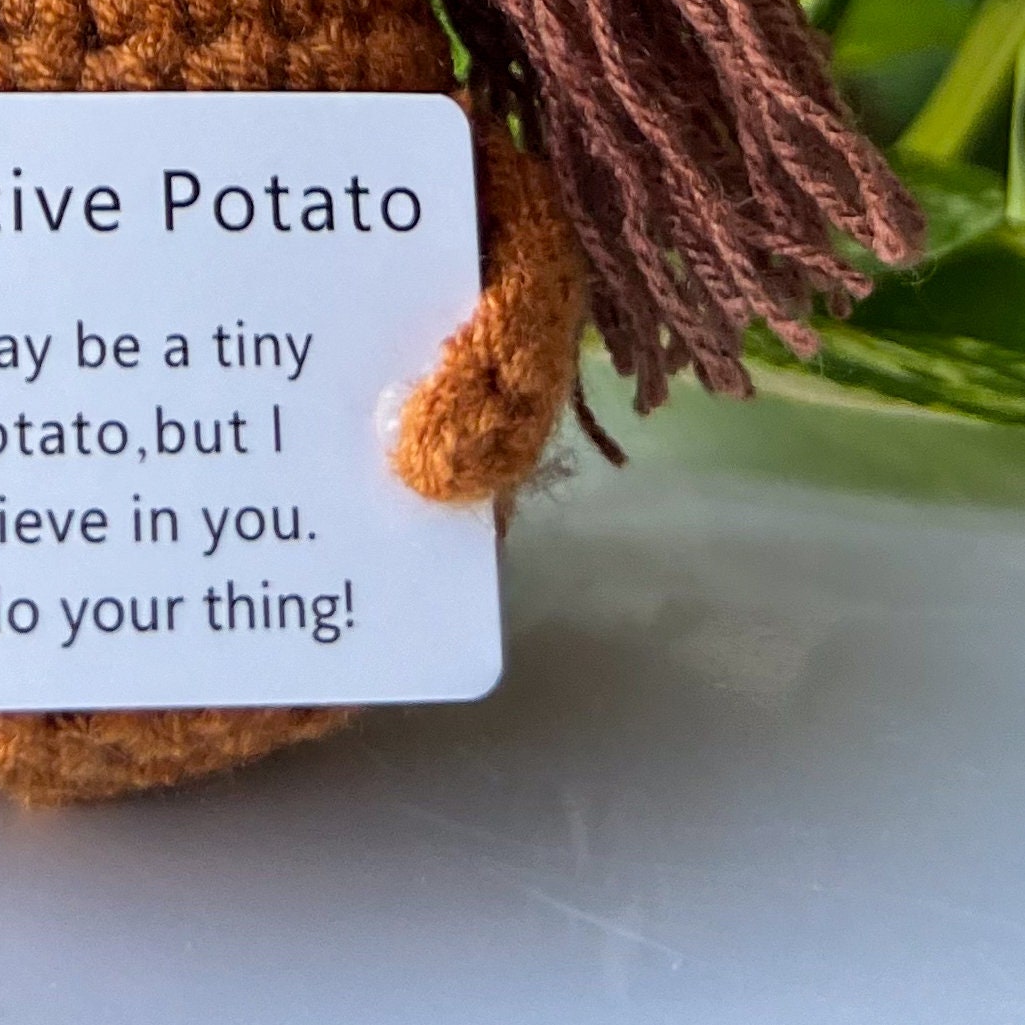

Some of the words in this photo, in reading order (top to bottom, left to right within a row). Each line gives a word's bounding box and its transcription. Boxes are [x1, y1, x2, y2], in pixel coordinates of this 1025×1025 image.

[163, 170, 422, 233] Potato
[76, 319, 141, 369] be
[163, 333, 190, 369] a
[211, 319, 313, 383] tiny
[272, 403, 282, 452] I
[132, 493, 179, 543] in
[201, 505, 317, 558] you.
[59, 596, 185, 650] your
[202, 579, 357, 645] thing!
